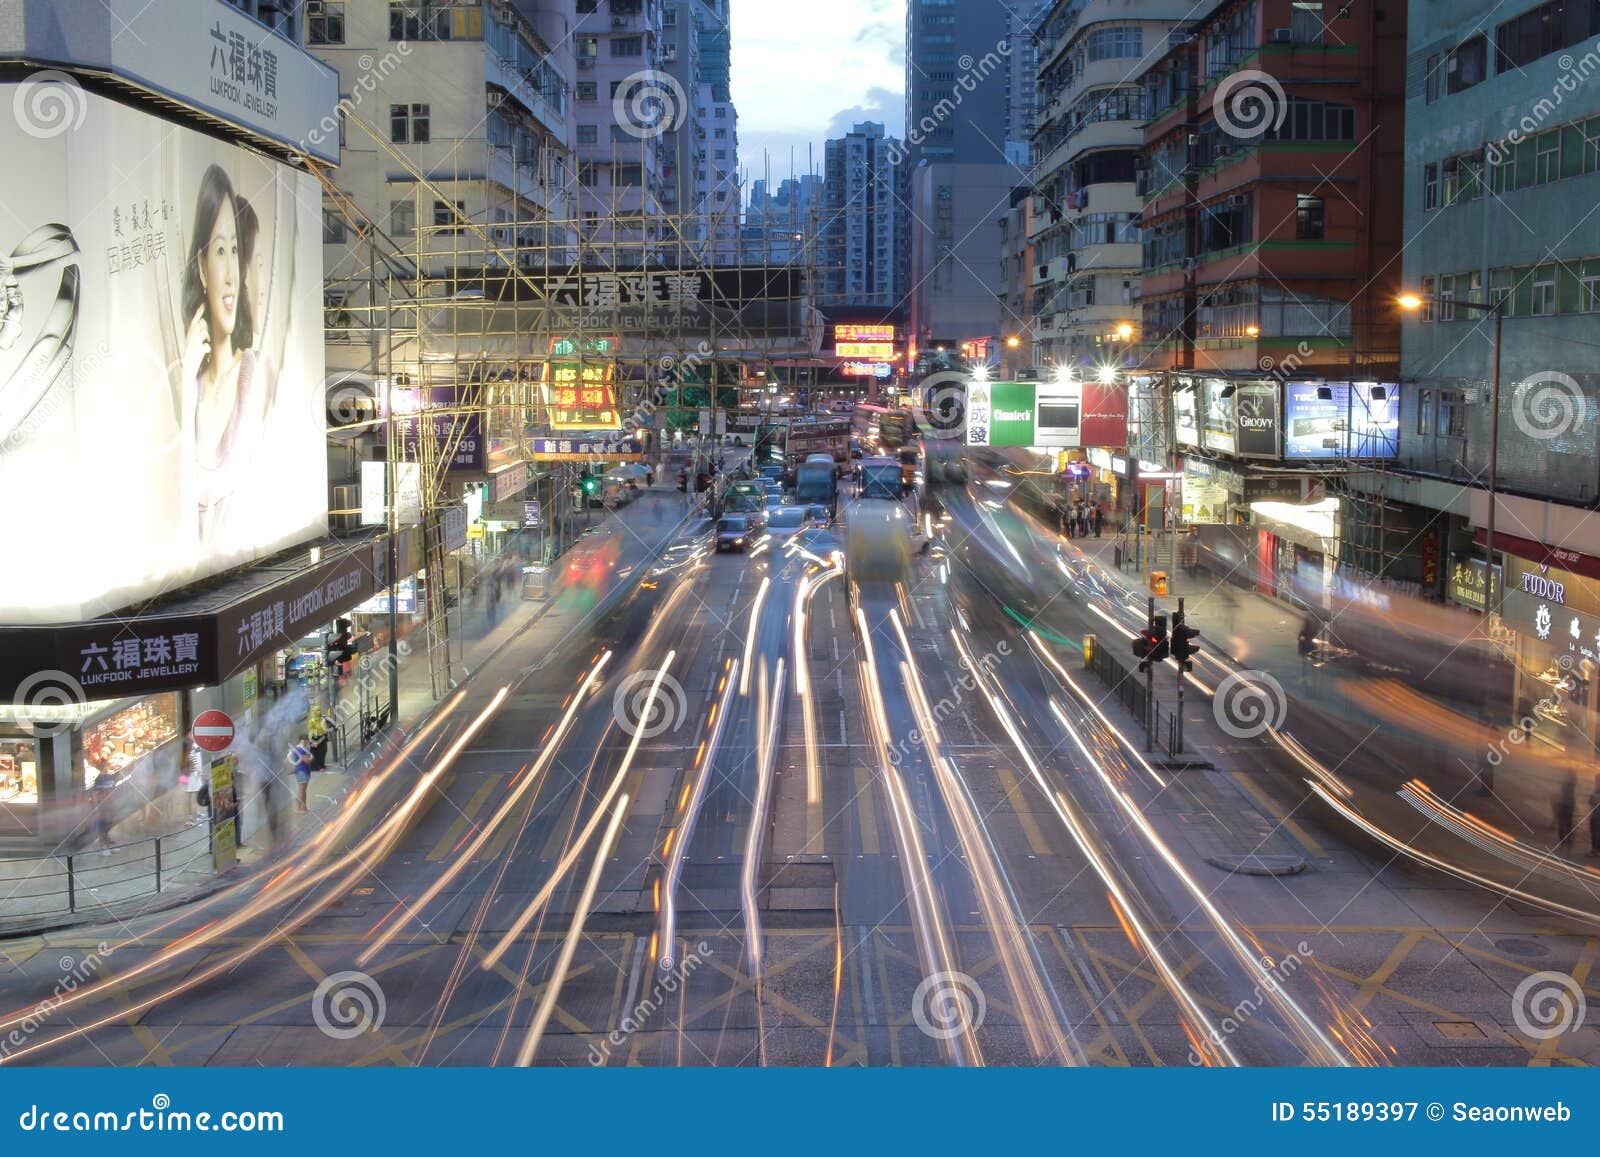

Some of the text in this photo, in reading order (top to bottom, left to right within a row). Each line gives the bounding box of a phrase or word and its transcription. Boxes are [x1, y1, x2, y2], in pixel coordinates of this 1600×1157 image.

[210, 21, 278, 100] 六福珠寶
[210, 76, 278, 120] LUKFOOK JEWELLERY
[544, 274, 701, 313] 六福珠寶
[1240, 415, 1273, 428] GROOVY
[1521, 572, 1564, 603] TUDOR
[237, 600, 284, 656] 六福珠寶
[289, 587, 323, 624] LUKFOOK
[325, 568, 362, 606] JEWELLERY
[80, 632, 199, 673] 六福珠寶
[81, 662, 199, 685] LUKFOOK JEWELLERY
